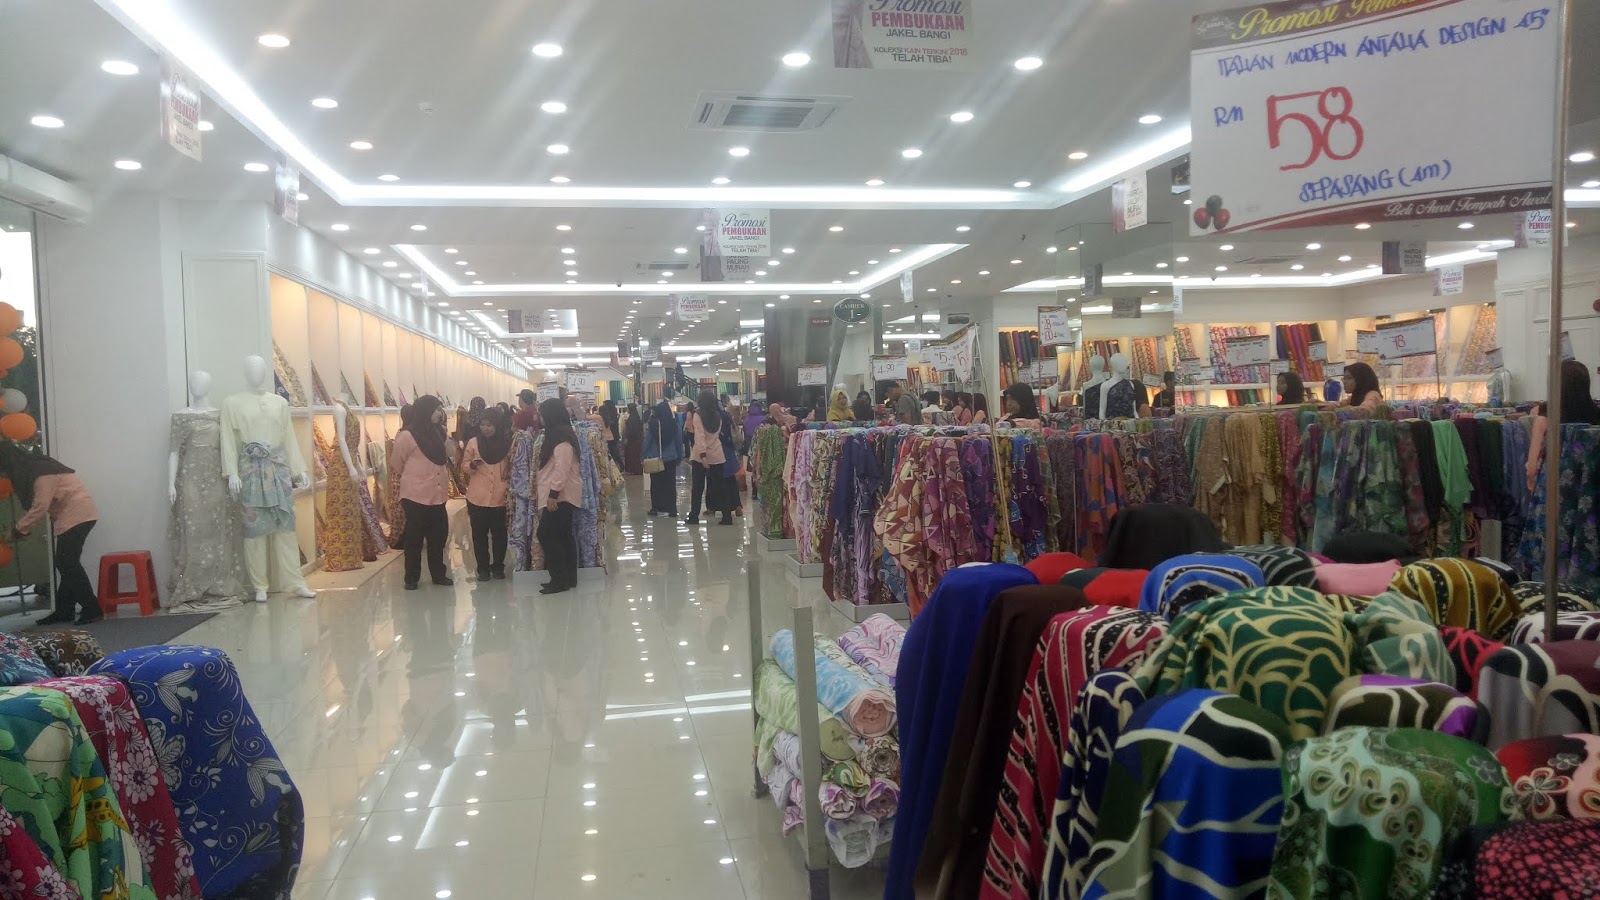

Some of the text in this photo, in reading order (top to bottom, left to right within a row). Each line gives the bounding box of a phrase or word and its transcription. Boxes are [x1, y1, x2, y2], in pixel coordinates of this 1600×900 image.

[871, 12, 965, 31] PEMBUKAAN
[1232, 3, 1341, 39] Promosi
[886, 28, 951, 39] JAKEL BANGI
[1285, 40, 1347, 65] MODERN
[1438, 17, 1506, 46] DESIGN
[892, 53, 952, 63] TELAH TIBA!
[1214, 106, 1244, 127] RM
[1266, 86, 1364, 171] 58
[1299, 169, 1394, 203] SEPASANG
[721, 213, 768, 228] Promosi
[1528, 210, 1552, 222] Prom
[722, 227, 767, 236] PEMBUKAAN
[1528, 222, 1552, 230] PEMBU
